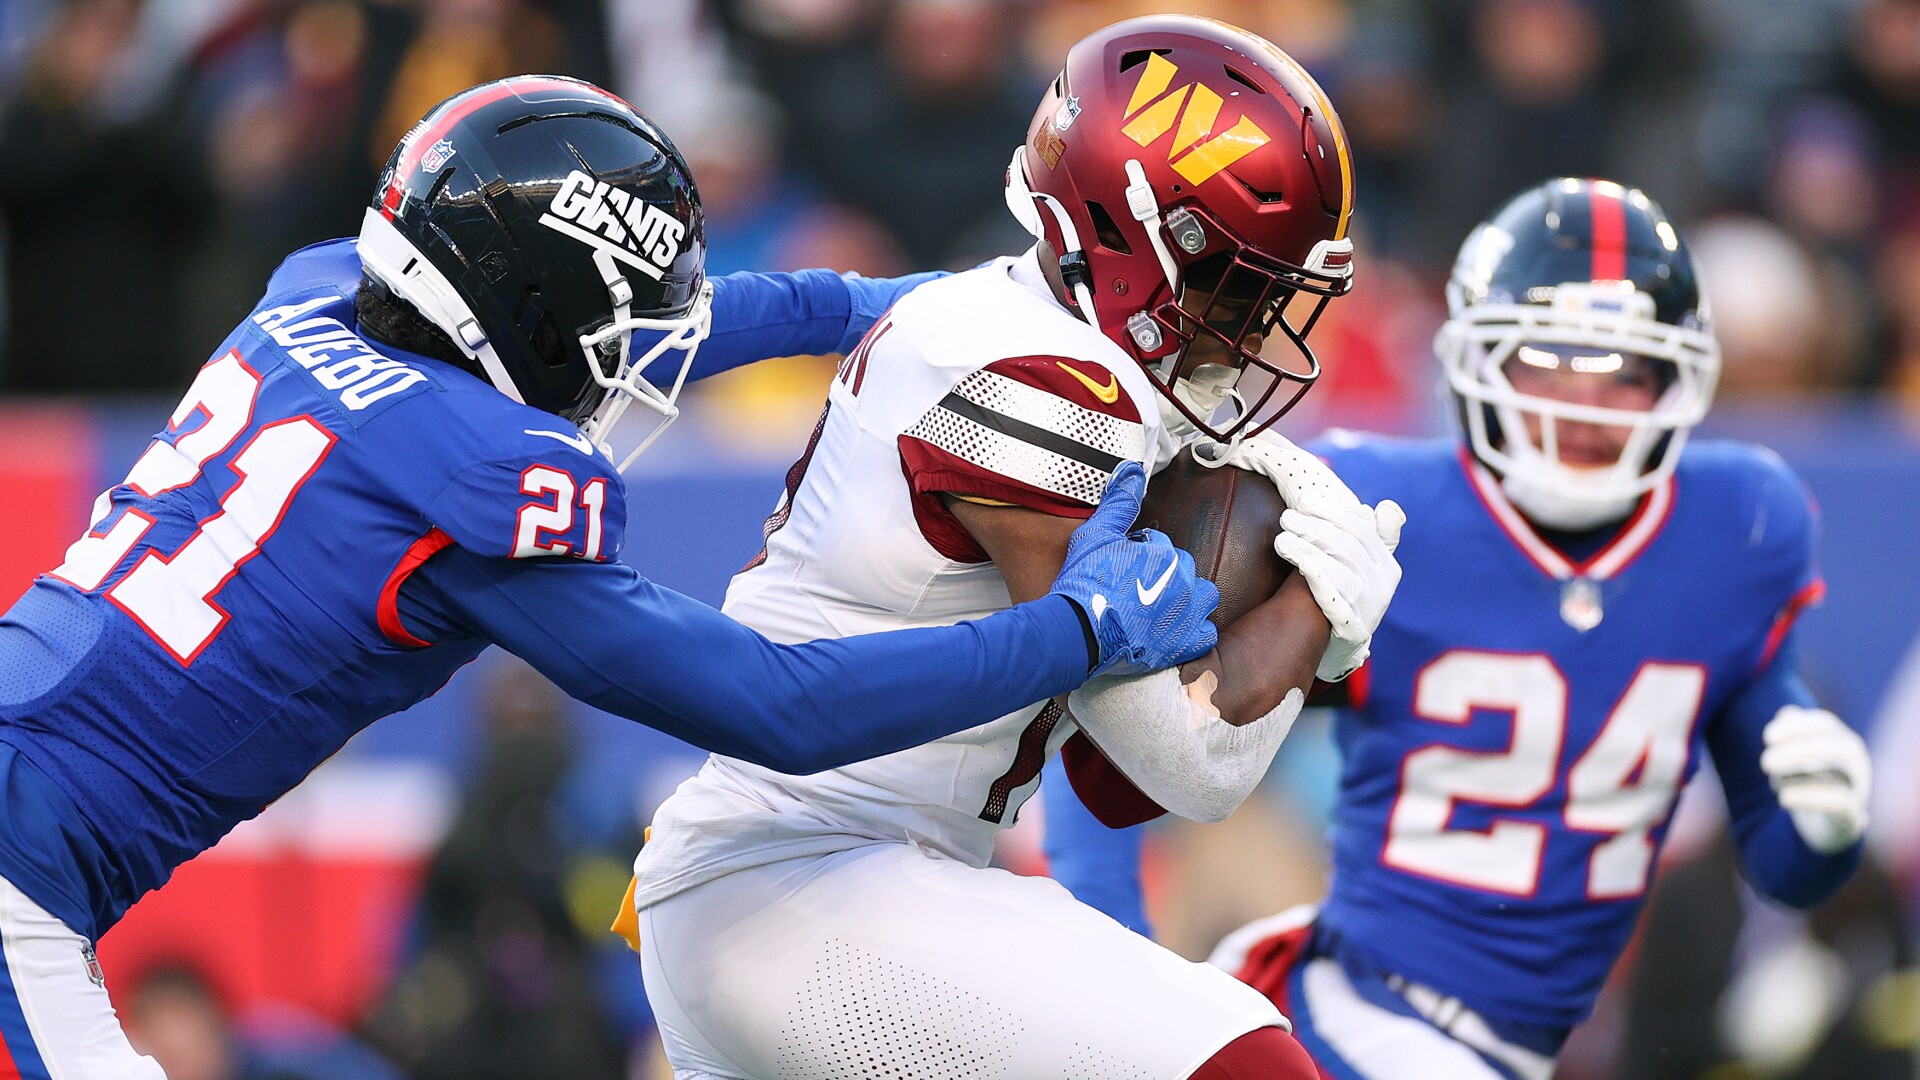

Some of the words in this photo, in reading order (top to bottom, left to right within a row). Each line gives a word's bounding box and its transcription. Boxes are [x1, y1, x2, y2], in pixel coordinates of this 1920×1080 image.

[550, 169, 686, 268] GIANTS
[252, 295, 428, 411] ADEBO
[38, 347, 339, 669] 21
[507, 462, 608, 563] 21
[1381, 647, 1707, 900] 24
